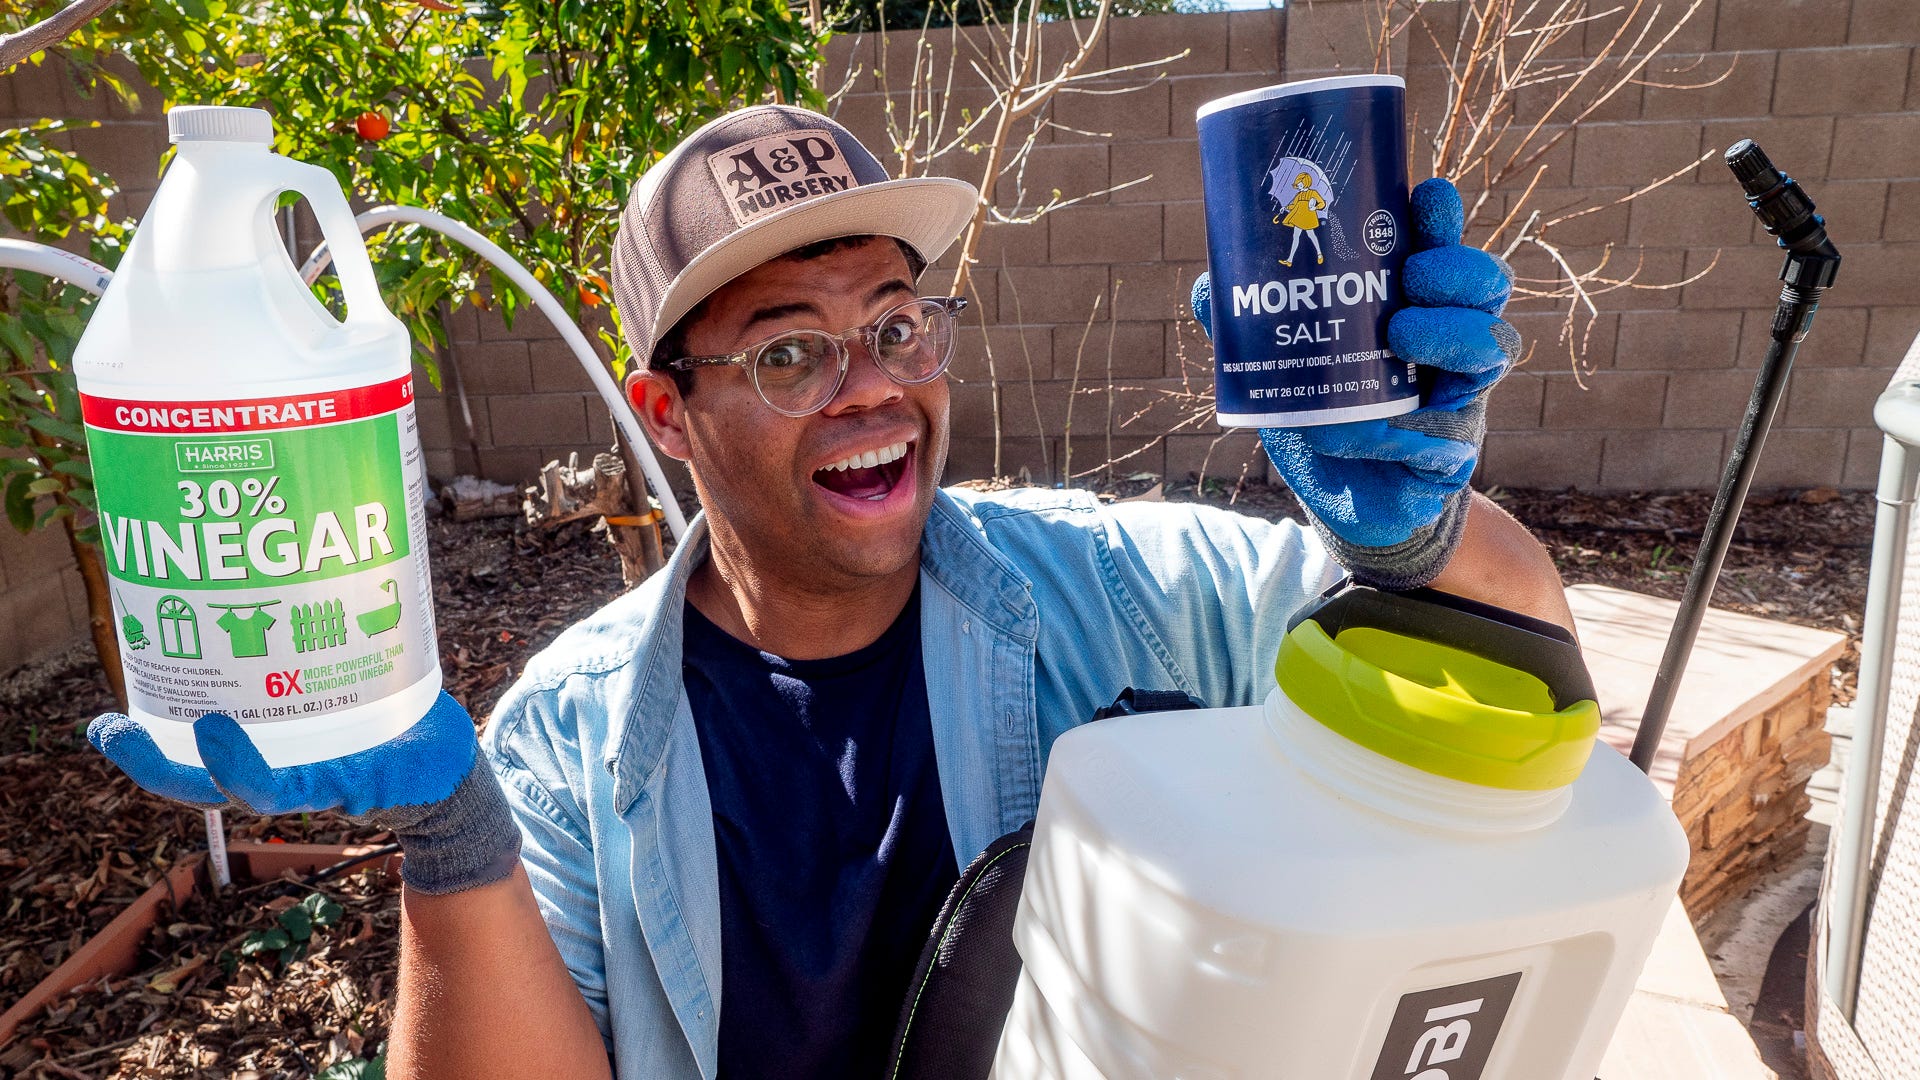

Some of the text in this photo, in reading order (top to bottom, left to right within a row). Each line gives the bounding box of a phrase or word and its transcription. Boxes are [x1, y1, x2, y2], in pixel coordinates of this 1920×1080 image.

[726, 136, 836, 199] A&P
[737, 175, 849, 218] NURSERY
[1367, 213, 1393, 227] TRUSTED
[1368, 226, 1394, 239] 1848
[1370, 240, 1393, 252] QUALITY
[1275, 318, 1346, 346] SALT
[1232, 362, 1244, 373] SALT
[1244, 361, 1261, 372] DOES
[1262, 360, 1277, 371] NOT
[1277, 358, 1305, 370] SUPPLY
[1306, 355, 1335, 367] IODIDE,
[1335, 354, 1342, 364] A
[1342, 349, 1382, 364] NECESSARY
[401, 383, 408, 399] 6
[1249, 379, 1380, 399] NET WT 26 OZ (1 LB 10 OZ) 737g
[115, 397, 337, 428] CONCENTRATE
[185, 444, 263, 463] HARRIS
[177, 475, 287, 518] 30%
[103, 501, 395, 582] VINEGAR
[143, 660, 150, 669] OF
[151, 661, 171, 673] REACH
[171, 666, 181, 674] OF
[182, 667, 224, 676] CHILDREN.
[303, 642, 404, 681] MORE POWERFUL THAN
[140, 670, 161, 682] CAUSES
[160, 676, 173, 685] EYE
[174, 678, 190, 687] AND
[190, 679, 209, 688] SKIN
[210, 680, 242, 688] BURNS.
[265, 669, 304, 698] 6X
[305, 660, 394, 694] STANDARD VINEGAR
[162, 686, 210, 698] SWALLOWED.
[166, 695, 181, 703] other
[181, 698, 220, 706] precautions.
[168, 705, 183, 717] NET
[233, 709, 239, 719] 1
[241, 708, 261, 719] GAL
[262, 706, 285, 719] (128
[286, 705, 302, 715] FL.
[303, 700, 323, 713] OZ.)
[324, 694, 348, 710] (3.78
[349, 692, 358, 703] L)
